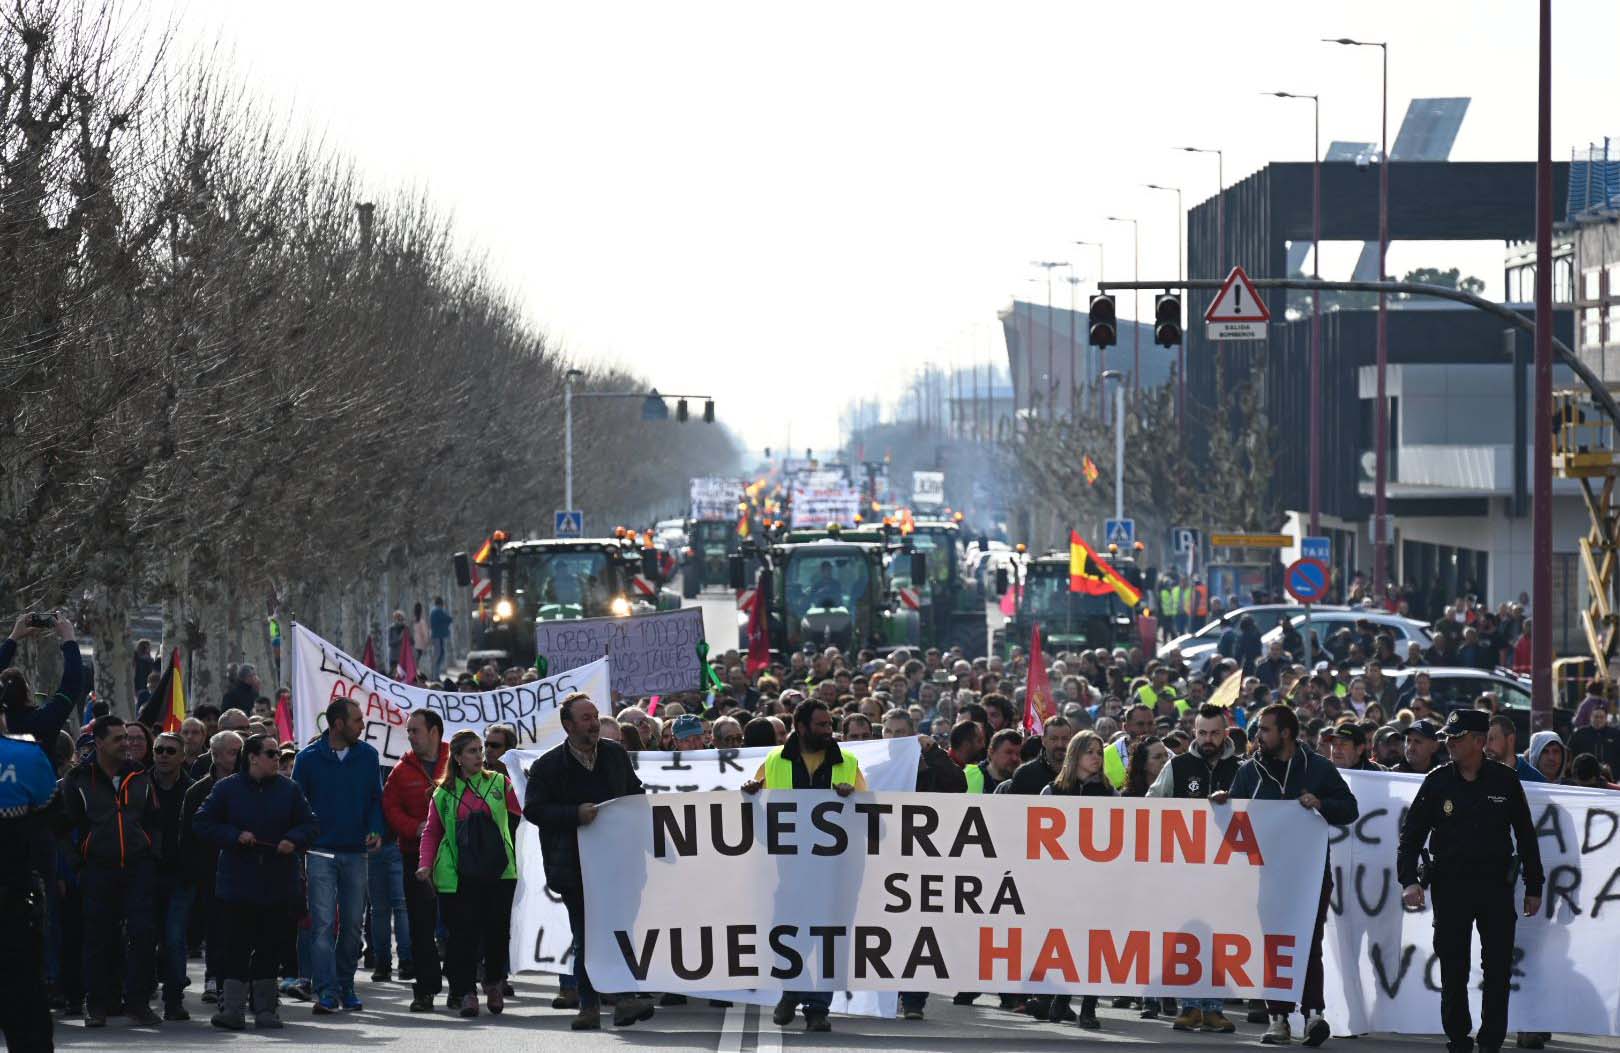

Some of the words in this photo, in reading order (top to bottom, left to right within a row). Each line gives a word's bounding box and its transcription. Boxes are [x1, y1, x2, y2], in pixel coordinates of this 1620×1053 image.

[1303, 546, 1329, 557] TAXI
[319, 644, 412, 710] LEYES
[426, 674, 578, 723] ABSURDAS
[651, 801, 998, 859] NUESTRA
[1026, 805, 1265, 867] RUINA
[883, 870, 1026, 915] SERÁ
[613, 924, 950, 981] VUESTRA
[978, 926, 1296, 990] HAMBRE
